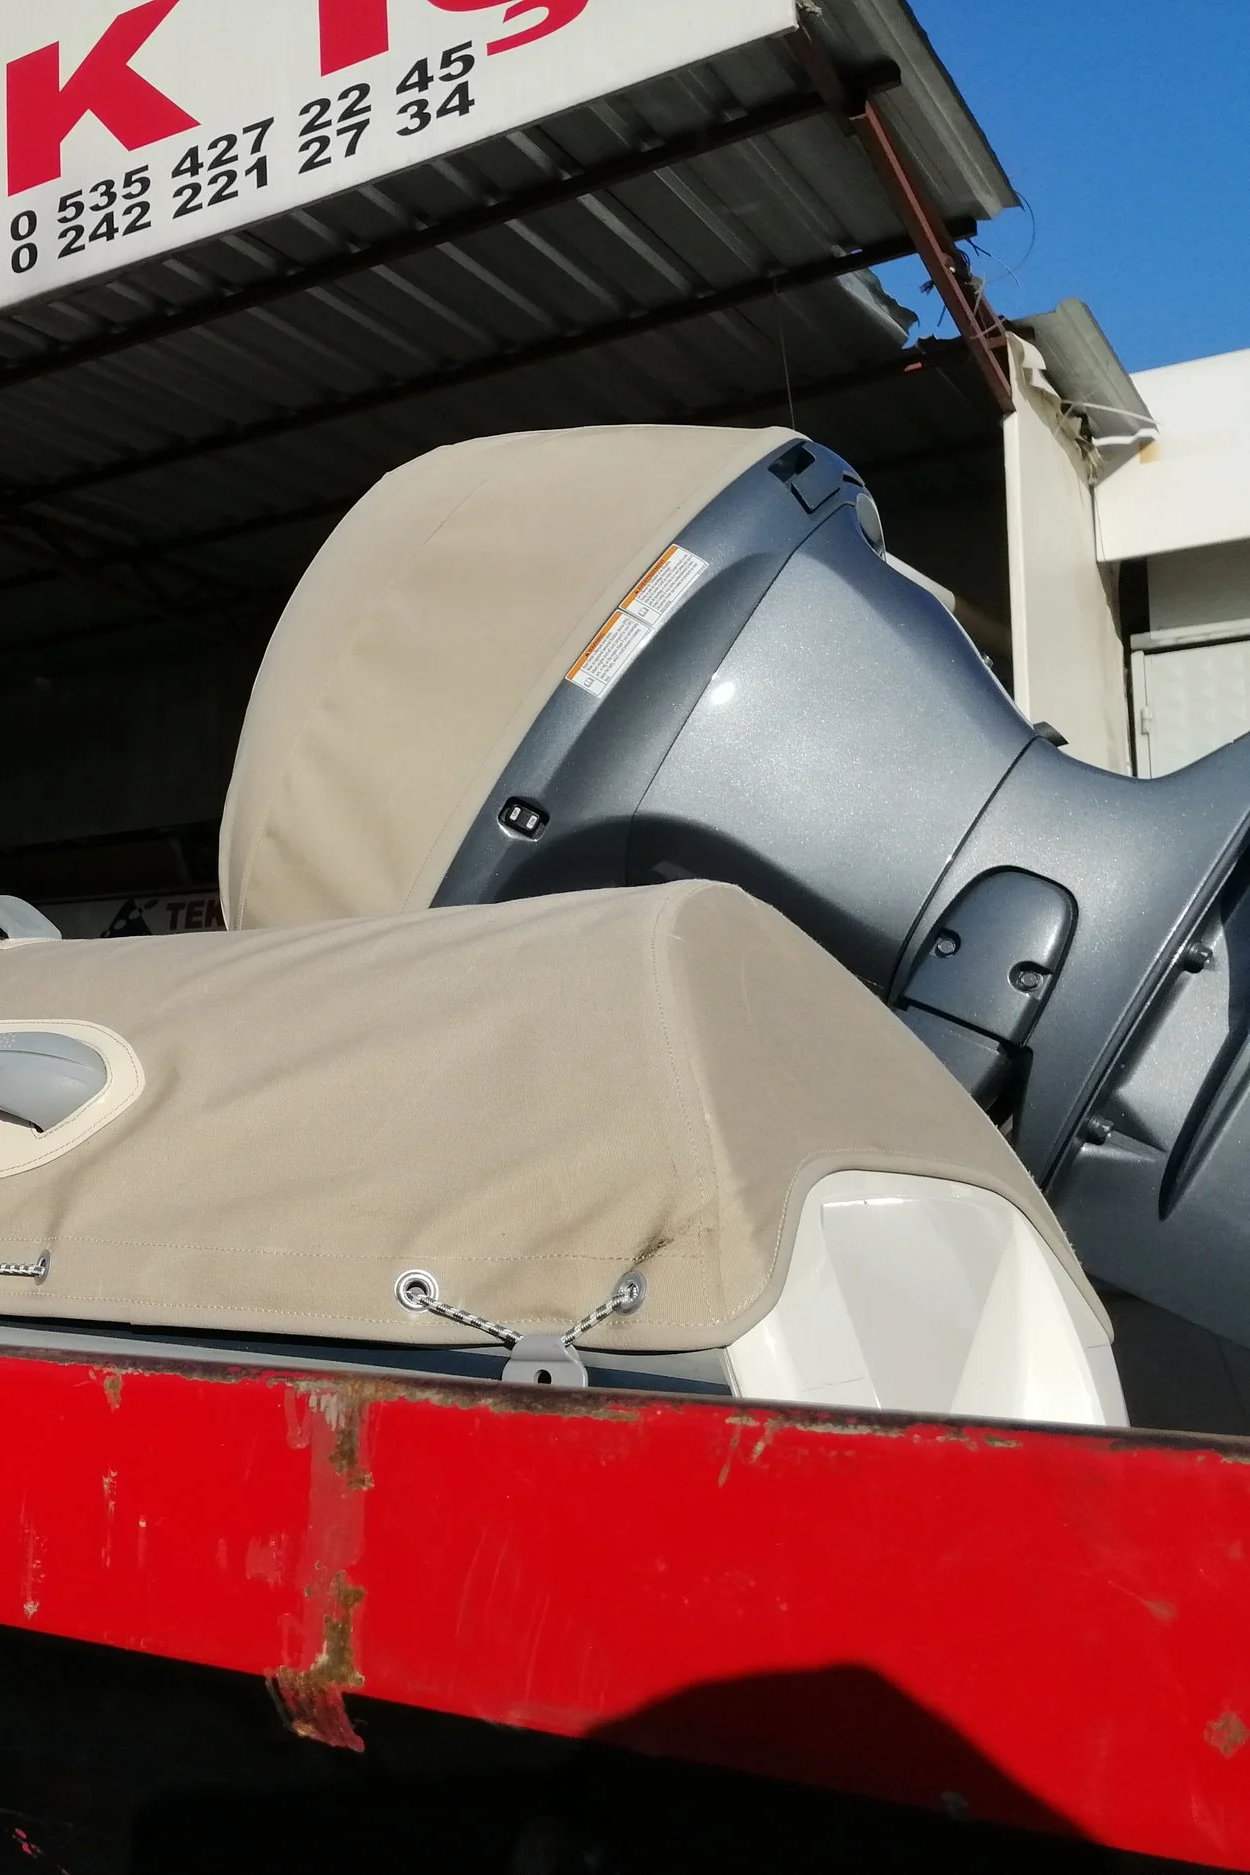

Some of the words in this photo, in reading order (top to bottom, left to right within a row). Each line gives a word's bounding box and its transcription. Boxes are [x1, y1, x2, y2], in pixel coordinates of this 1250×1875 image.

[10, 209, 37, 241] 0
[57, 164, 151, 225] 535
[171, 117, 275, 179] 427
[298, 82, 372, 138] 22
[396, 40, 475, 95] 45
[10, 242, 38, 273] 0
[57, 200, 151, 260] 242
[172, 156, 269, 219] 221
[298, 117, 371, 175] 27
[396, 80, 475, 137] 34
